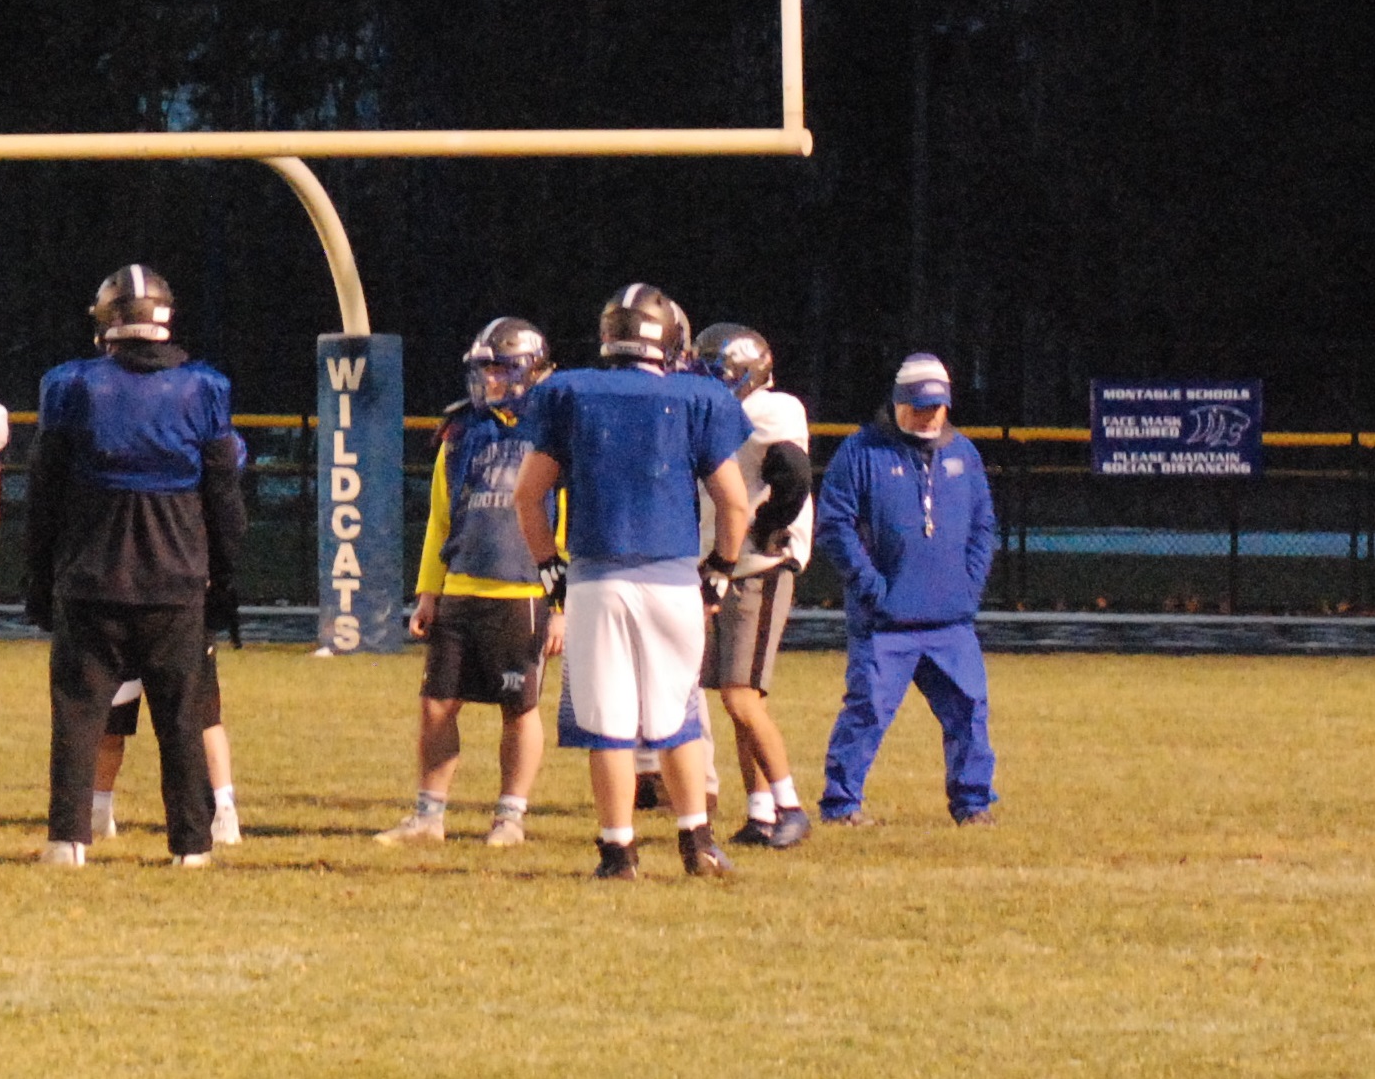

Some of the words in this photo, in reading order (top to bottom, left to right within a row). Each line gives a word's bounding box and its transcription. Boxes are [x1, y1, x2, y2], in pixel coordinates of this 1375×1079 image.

[1103, 388, 1181, 401] MONTAGUE
[1186, 388, 1251, 401] SCHOOLS
[1102, 415, 1136, 427] FACE
[1140, 415, 1182, 428] MASK
[1105, 426, 1180, 439] REQUIRED
[1113, 452, 1166, 463] PLEASE
[1170, 452, 1240, 463] MAINTAIN
[1102, 462, 1155, 474] SOCIAL
[1161, 462, 1251, 474] DISTANCING
[326, 356, 367, 651] WILDCATS
